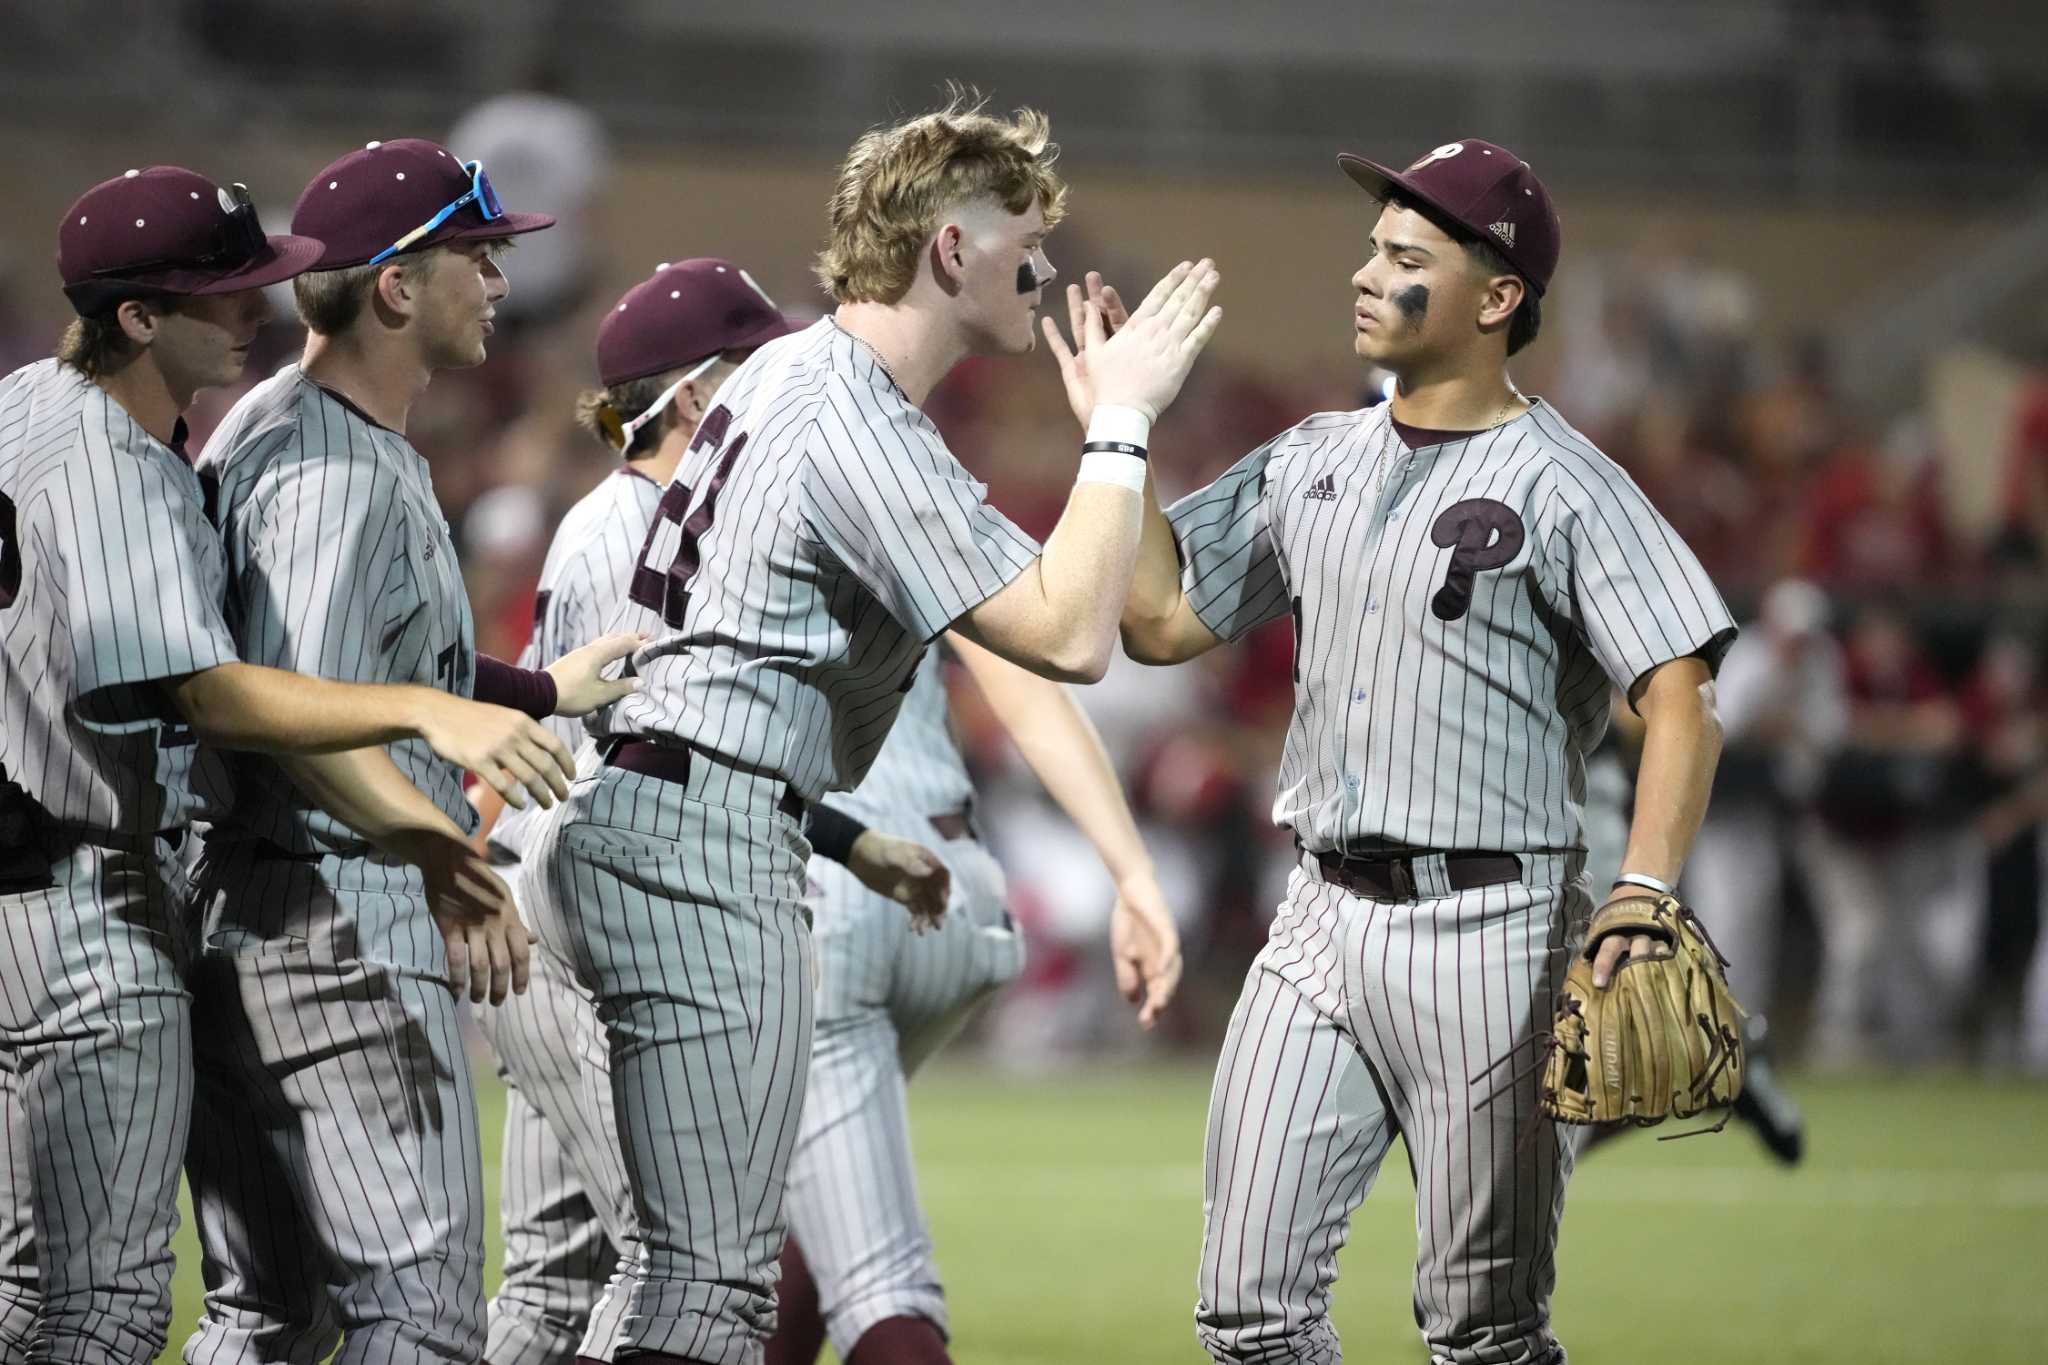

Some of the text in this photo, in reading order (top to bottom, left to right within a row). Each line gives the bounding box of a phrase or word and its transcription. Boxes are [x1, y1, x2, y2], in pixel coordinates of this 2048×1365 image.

[1410, 143, 1464, 171] P
[1489, 223, 1516, 248] adidas
[1302, 489, 1337, 501] adidas
[1431, 498, 1525, 621] P
